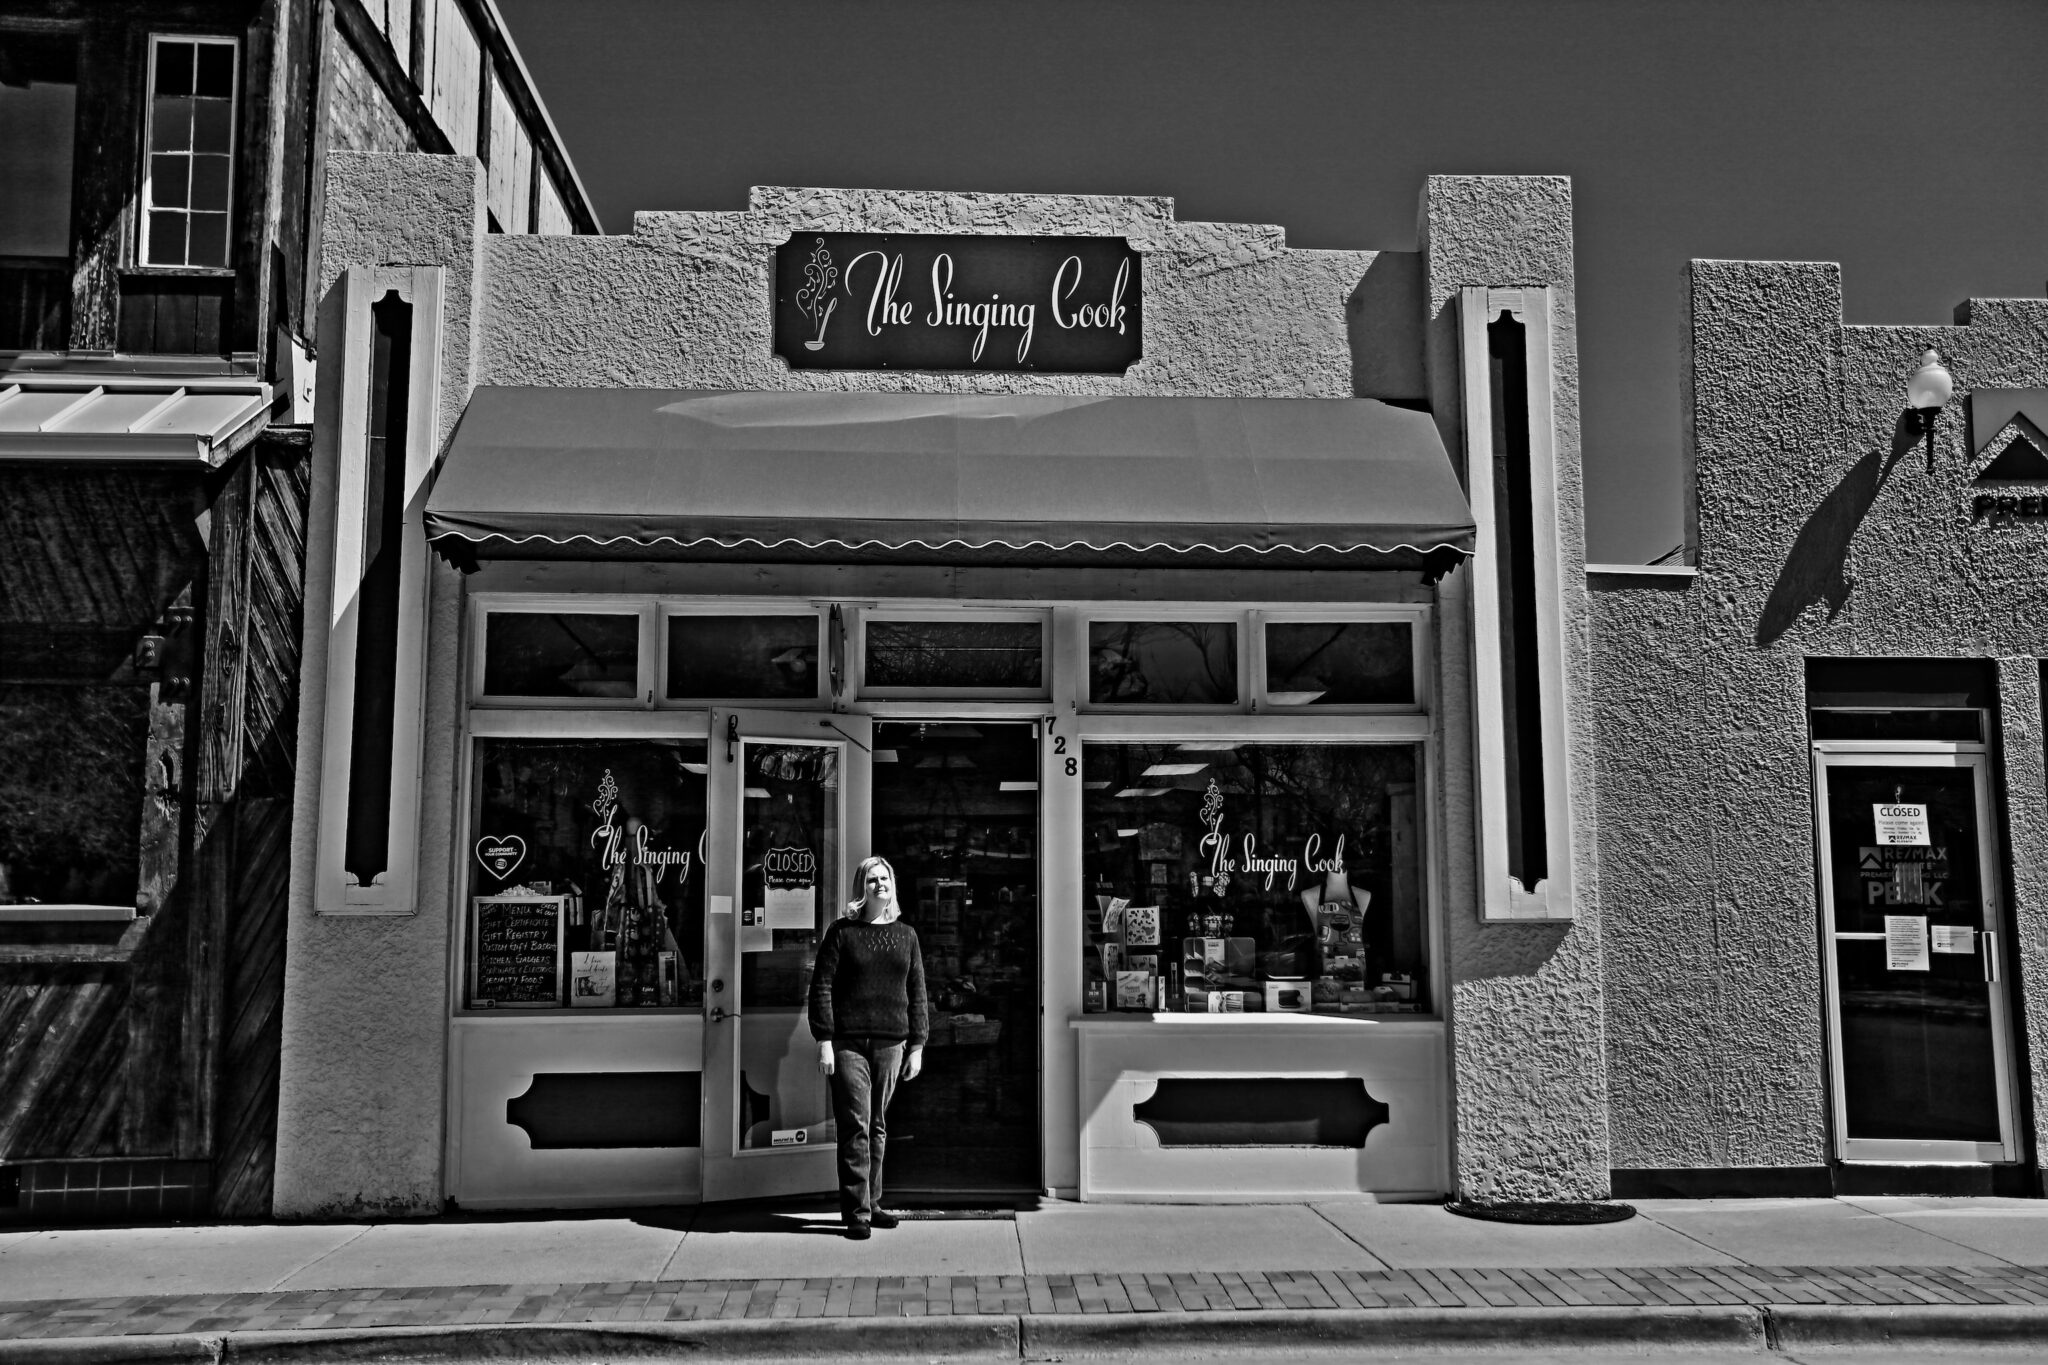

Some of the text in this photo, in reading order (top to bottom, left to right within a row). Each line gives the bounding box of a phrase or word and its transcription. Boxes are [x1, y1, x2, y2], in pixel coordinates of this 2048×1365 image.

[844, 250, 1130, 363] The Singing Cook
[1976, 496, 2048, 517] PRE
[1880, 807, 1921, 817] CLOSED
[591, 824, 627, 870] The
[633, 824, 691, 884] Singing
[767, 852, 813, 872] CLOSED
[1200, 832, 1345, 891] The Singing Cook
[1884, 847, 1948, 860] RE/MAX
[1867, 881, 1944, 905] PEK
